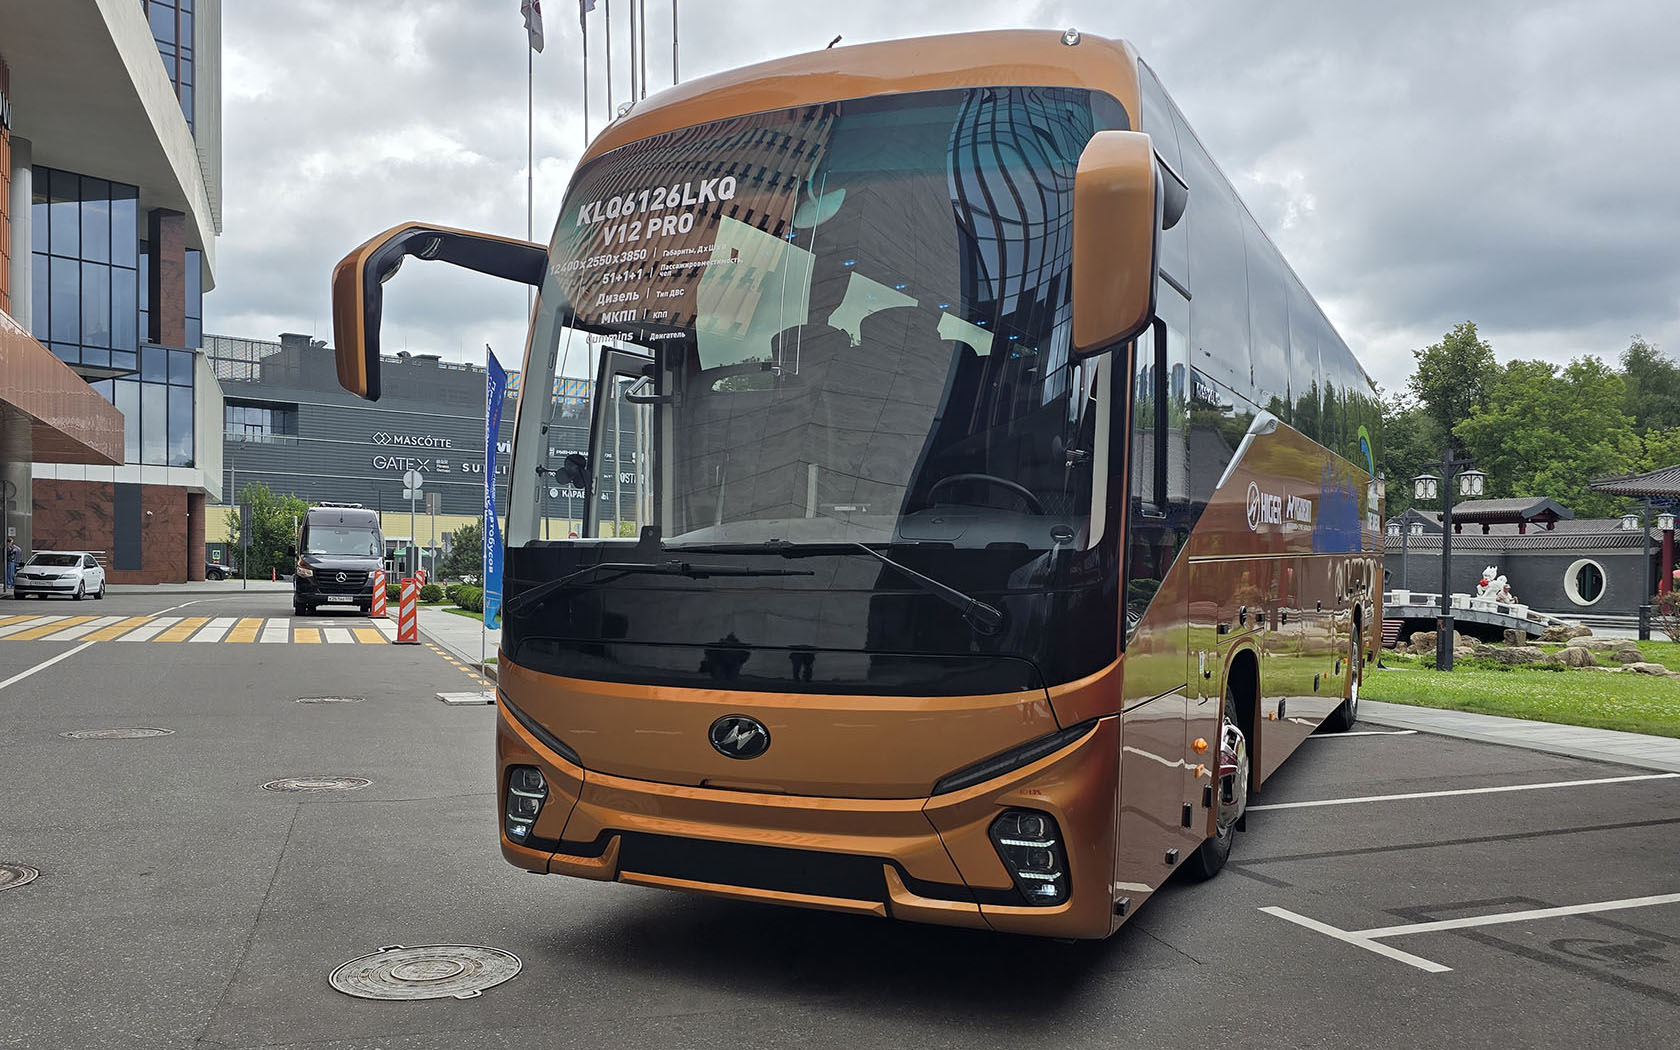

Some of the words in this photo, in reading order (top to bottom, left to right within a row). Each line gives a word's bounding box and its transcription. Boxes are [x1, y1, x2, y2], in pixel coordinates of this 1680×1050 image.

[576, 176, 737, 227] KLQ6126LKQ
[604, 220, 642, 246] V12
[646, 212, 694, 240] PRO
[662, 247, 697, 258] Габариты,
[602, 268, 643, 285] 51+1+1
[595, 291, 640, 307] Дизель
[656, 290, 669, 298] Тип
[669, 288, 685, 298] ДВС
[601, 309, 637, 324] МКПП
[653, 310, 668, 319] КПП
[585, 331, 634, 345] Cummins
[649, 331, 686, 341] Двигатель
[393, 434, 452, 448] MASCÓTTE
[1261, 492, 1282, 525] HIGER
